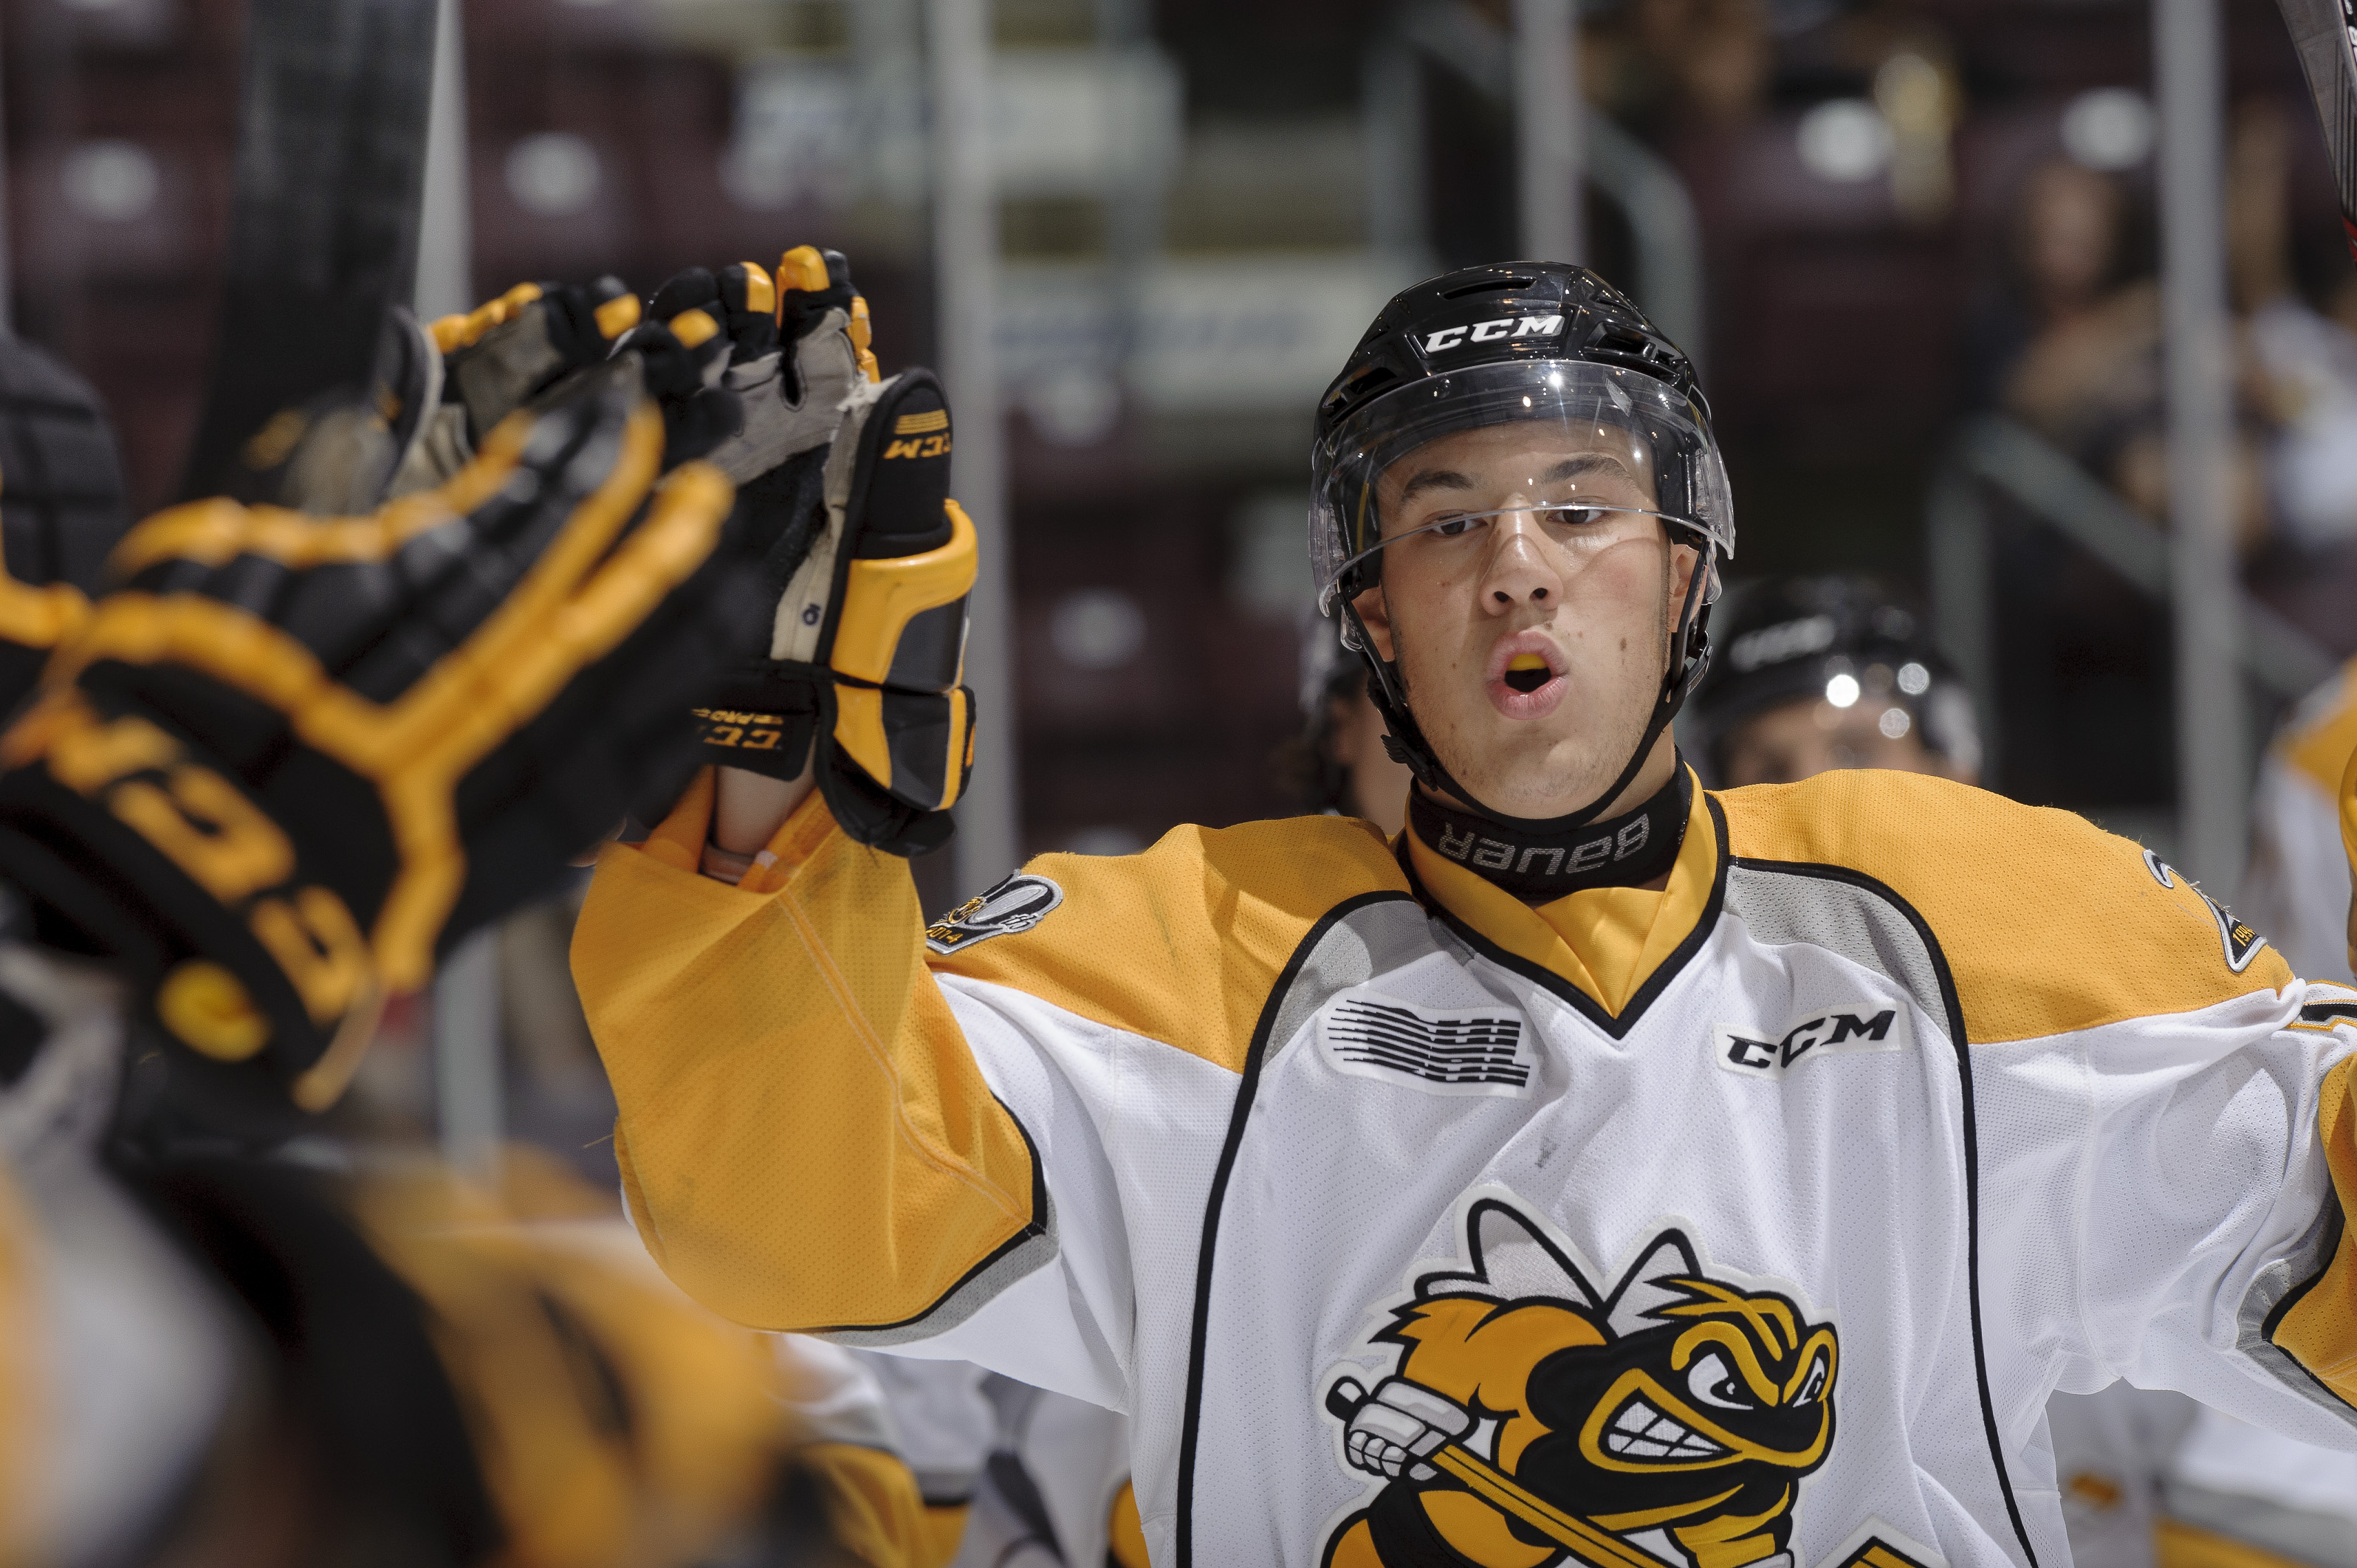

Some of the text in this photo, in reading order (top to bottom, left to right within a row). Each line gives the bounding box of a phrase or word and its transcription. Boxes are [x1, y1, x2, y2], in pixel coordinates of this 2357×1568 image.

[1425, 314, 1562, 353] CCM
[697, 726, 781, 749] CC
[1727, 1010, 1895, 1068] CCM
